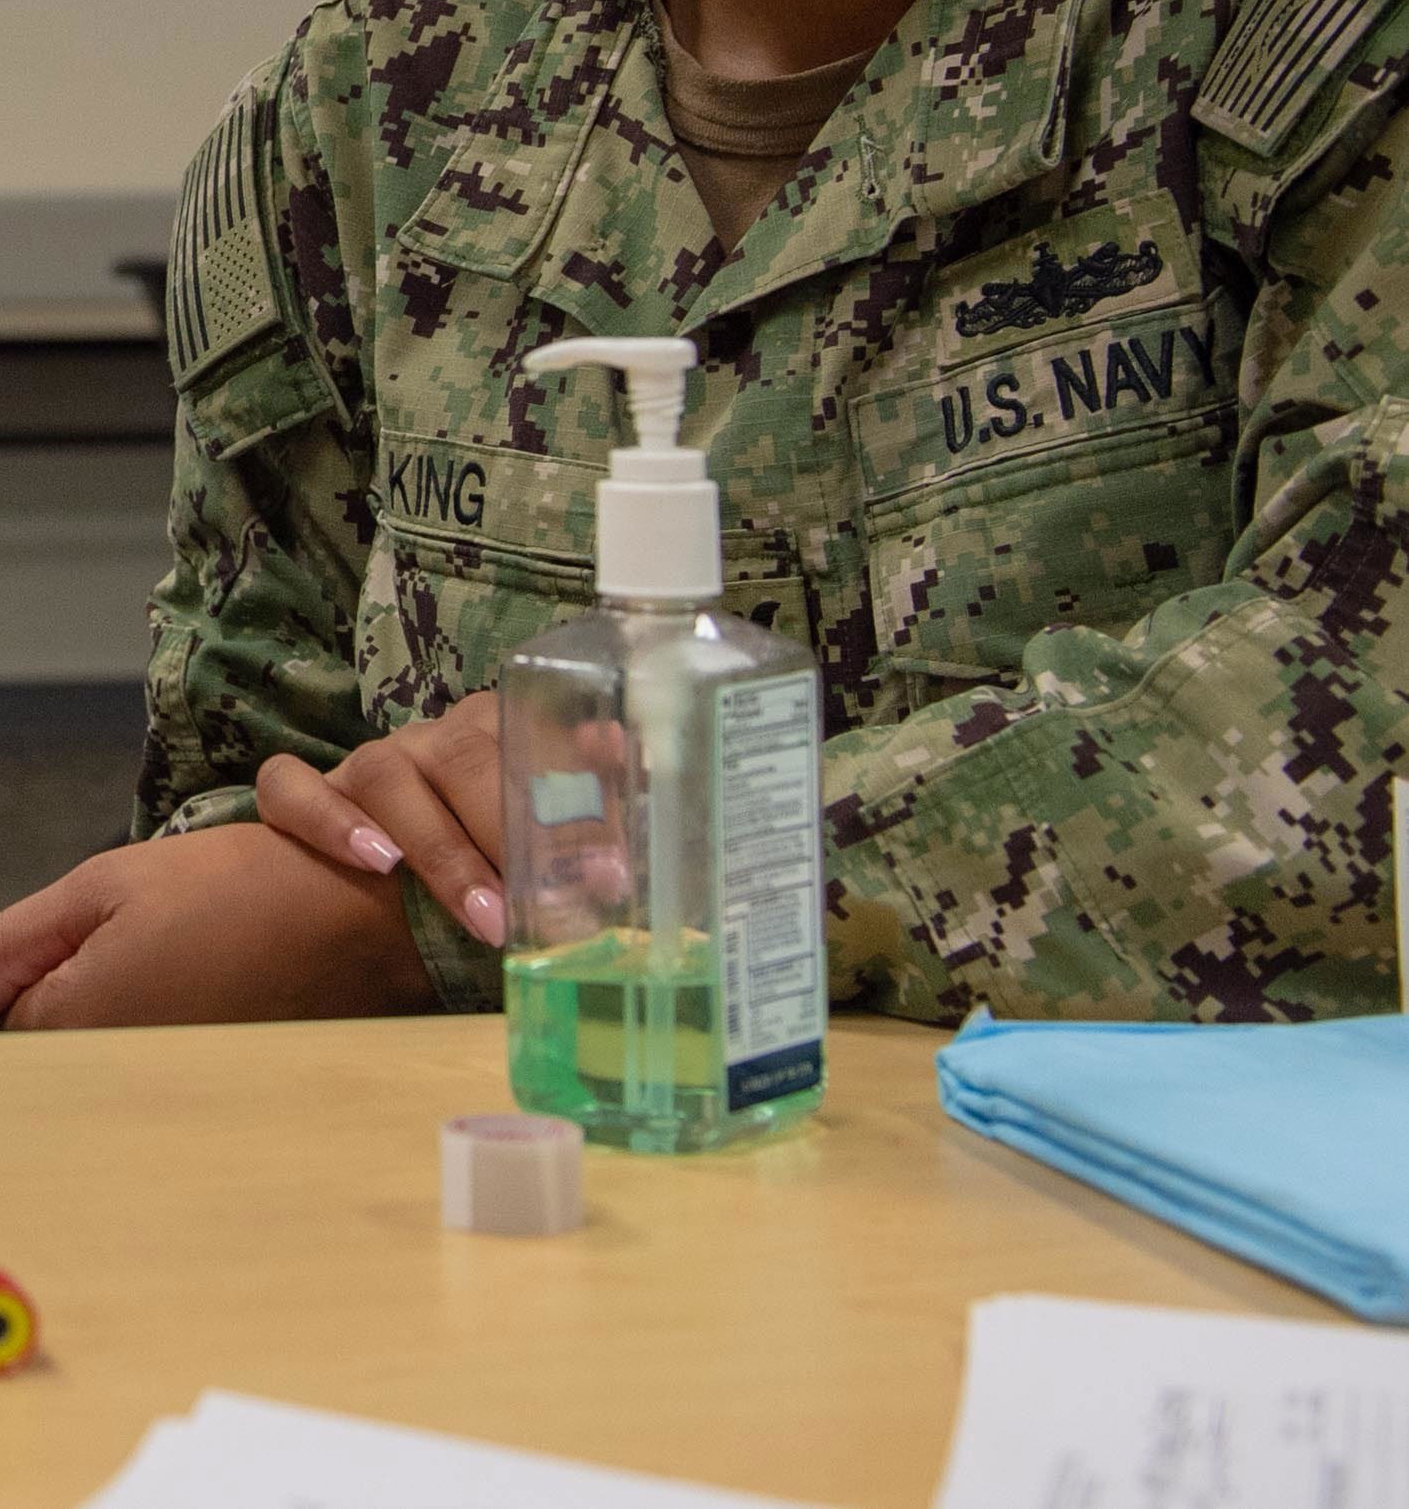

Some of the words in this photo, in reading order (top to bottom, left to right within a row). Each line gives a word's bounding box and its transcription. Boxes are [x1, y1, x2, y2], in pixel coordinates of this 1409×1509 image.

[941, 373, 1044, 454] U.S.
[1050, 322, 1216, 421] NAVY
[388, 451, 486, 527] KING
